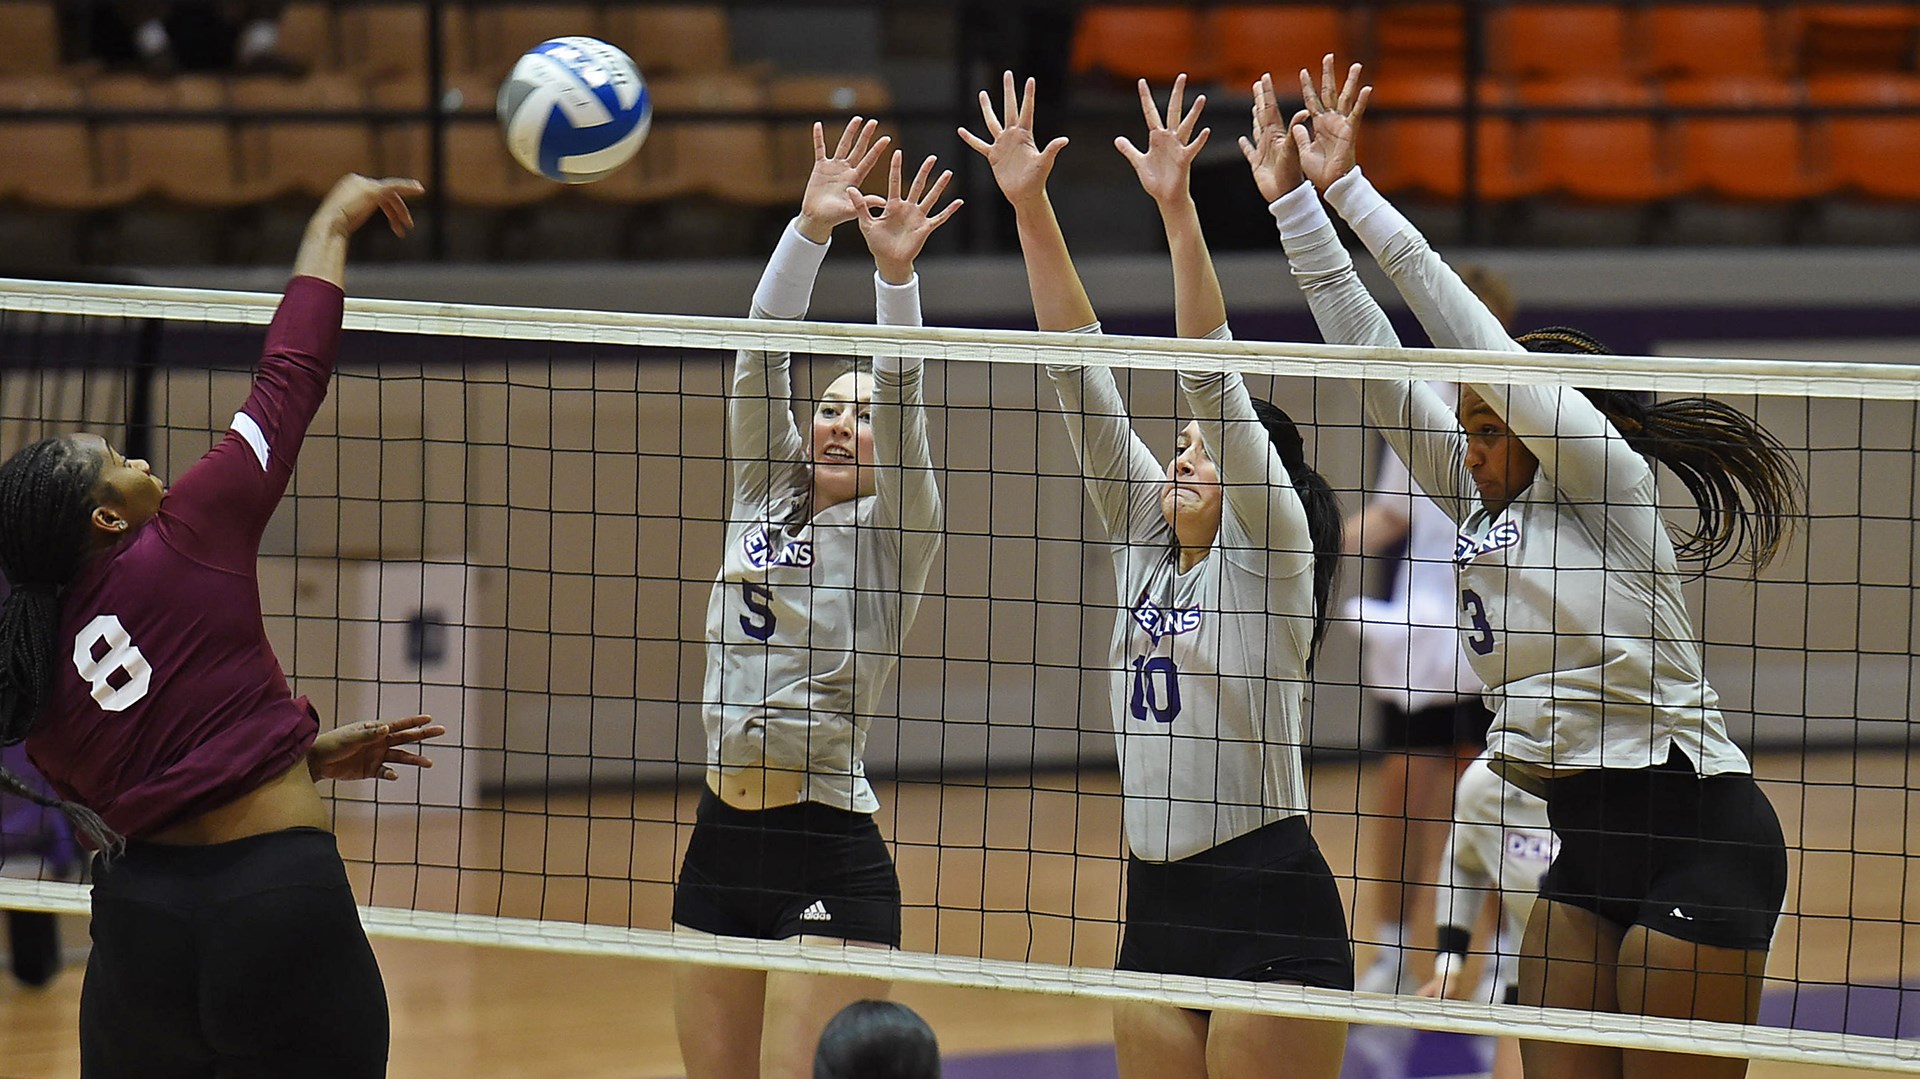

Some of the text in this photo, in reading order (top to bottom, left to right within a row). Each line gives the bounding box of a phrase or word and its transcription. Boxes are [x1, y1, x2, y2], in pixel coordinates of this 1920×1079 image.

[739, 577, 777, 641] 5
[1461, 588, 1494, 656] 3
[72, 614, 153, 712] 8
[1129, 654, 1182, 723] 10
